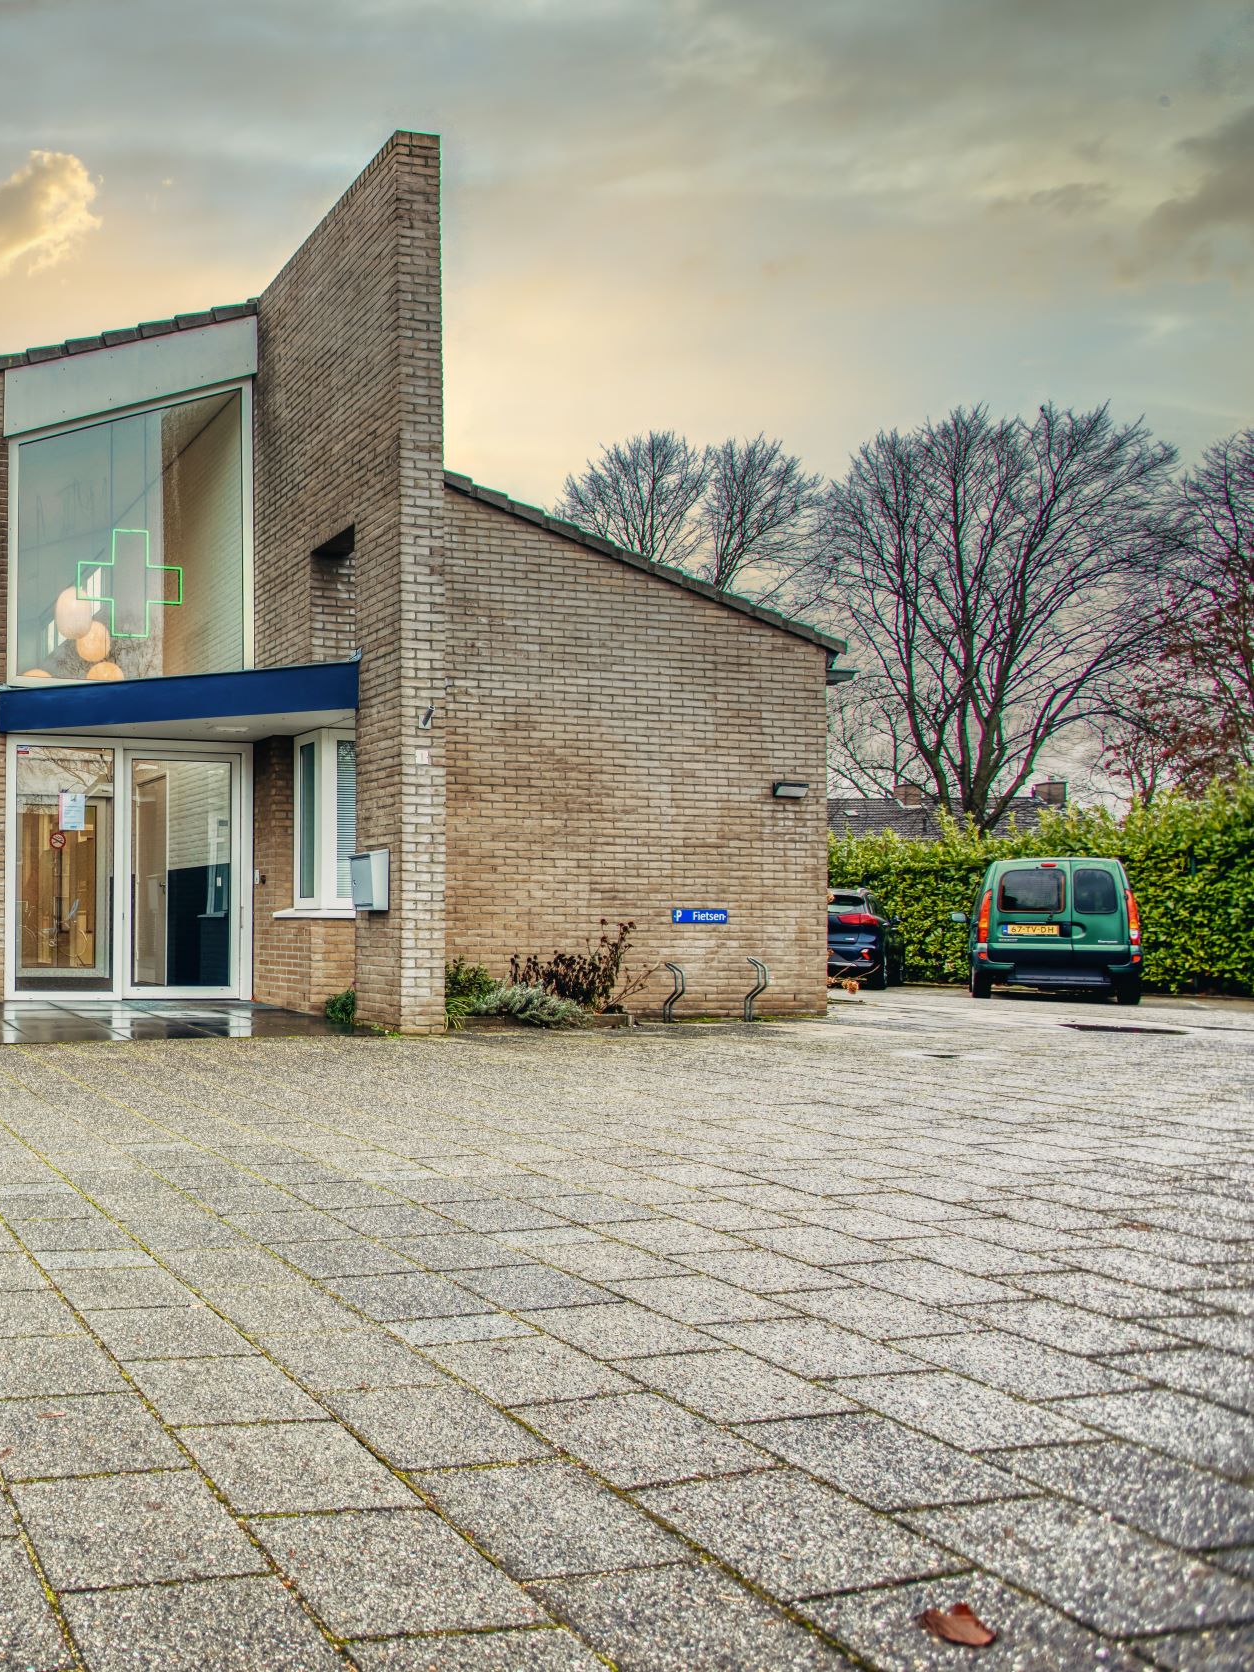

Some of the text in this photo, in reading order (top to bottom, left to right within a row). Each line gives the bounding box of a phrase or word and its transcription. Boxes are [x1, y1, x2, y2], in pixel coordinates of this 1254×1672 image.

[676, 910, 725, 922] P Fietsen
[1011, 926, 1054, 934] 67-TV-DH
